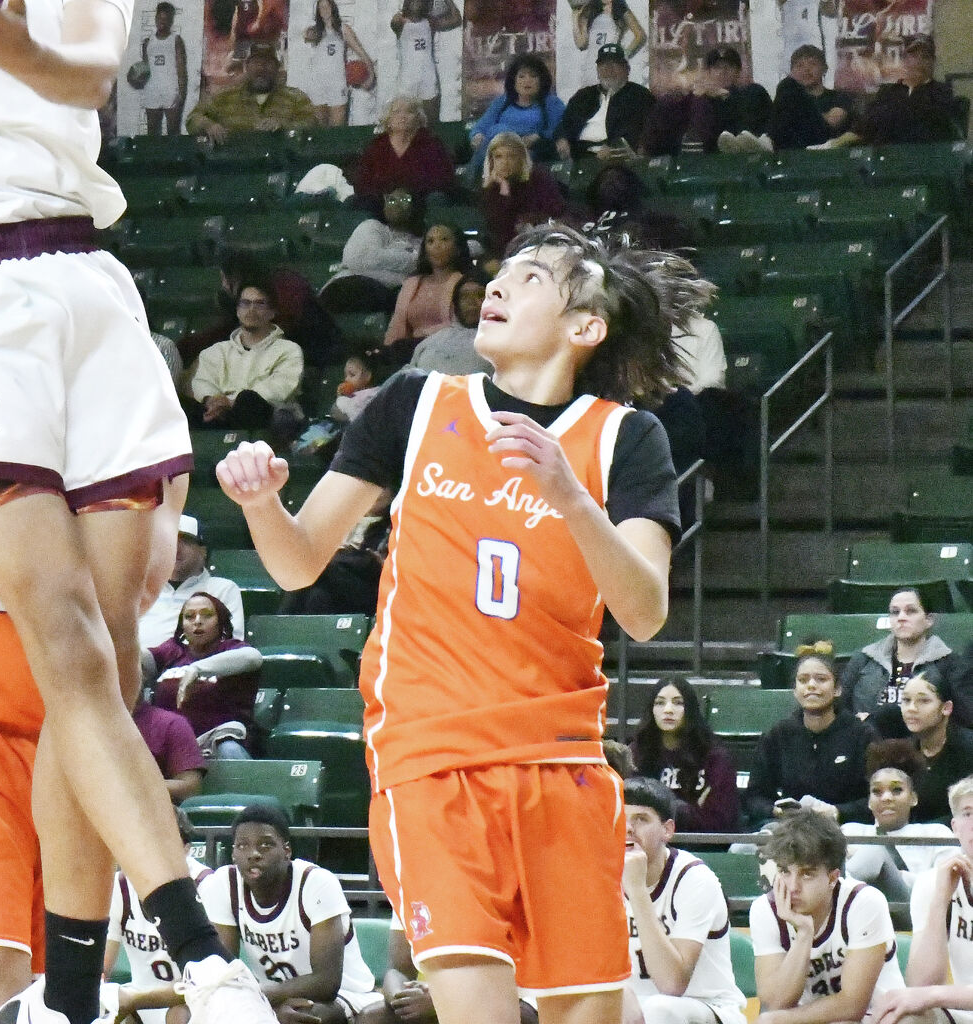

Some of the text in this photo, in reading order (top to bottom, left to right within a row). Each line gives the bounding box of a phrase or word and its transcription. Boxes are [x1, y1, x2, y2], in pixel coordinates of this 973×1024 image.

[417, 462, 475, 501] San
[476, 537, 521, 620] 0
[292, 765, 305, 775] 28
[190, 846, 204, 857] 28
[151, 960, 174, 982] 0
